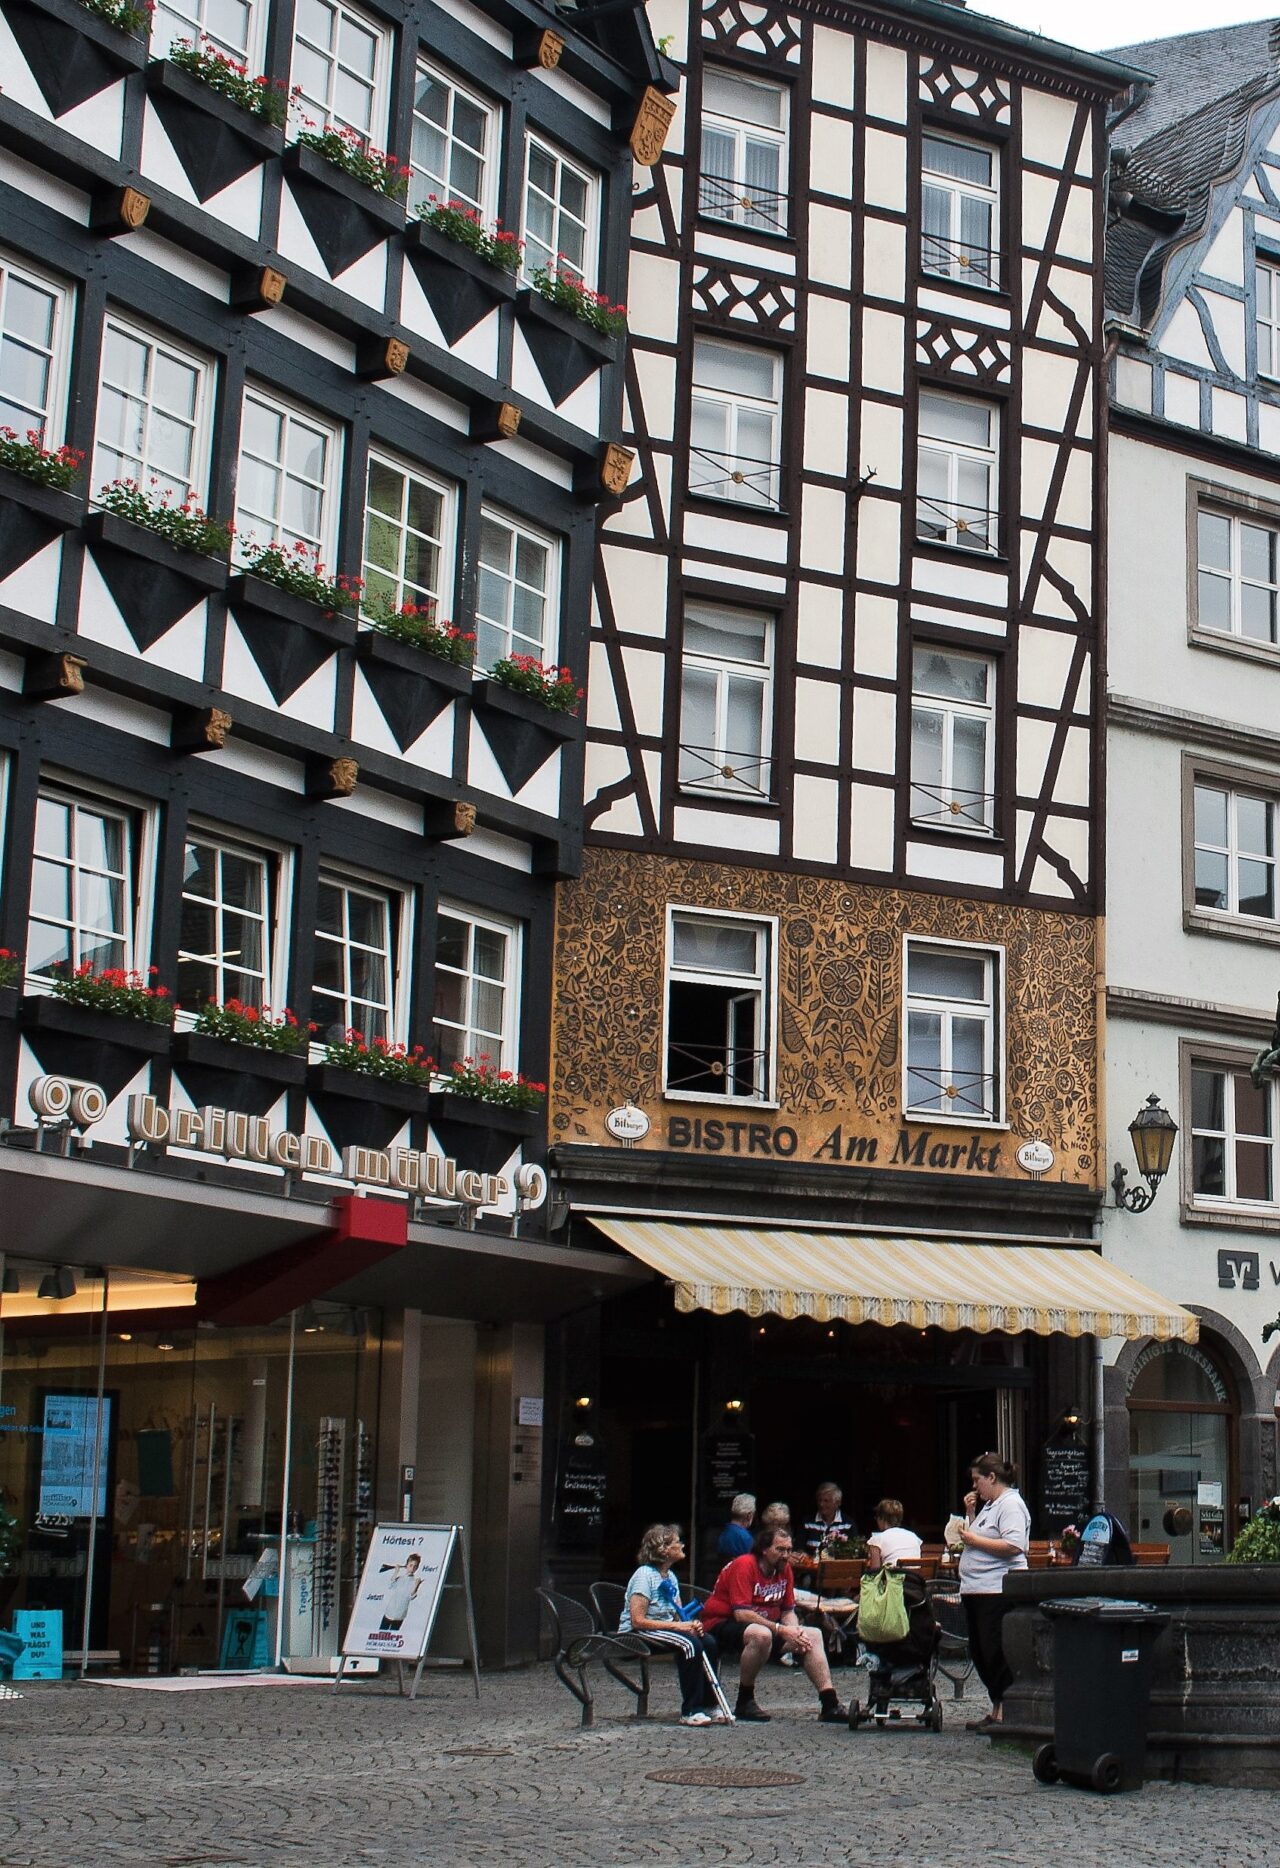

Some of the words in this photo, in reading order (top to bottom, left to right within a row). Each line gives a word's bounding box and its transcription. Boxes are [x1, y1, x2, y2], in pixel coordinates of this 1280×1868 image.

[130, 1093, 332, 1171] brillen
[345, 1146, 508, 1204] müller
[668, 1116, 798, 1156] BISTRO
[813, 1123, 878, 1163] Am
[890, 1130, 1001, 1172] Markt
[1177, 1343, 1227, 1402] VOLKSBANK
[382, 1535, 416, 1546] Hörtest
[418, 1537, 425, 1546] ?
[422, 1565, 438, 1573] Hier!
[31, 1621, 46, 1629] UND
[30, 1631, 46, 1639] WAS
[368, 1631, 403, 1642] müller
[31, 1651, 45, 1659] DU?
